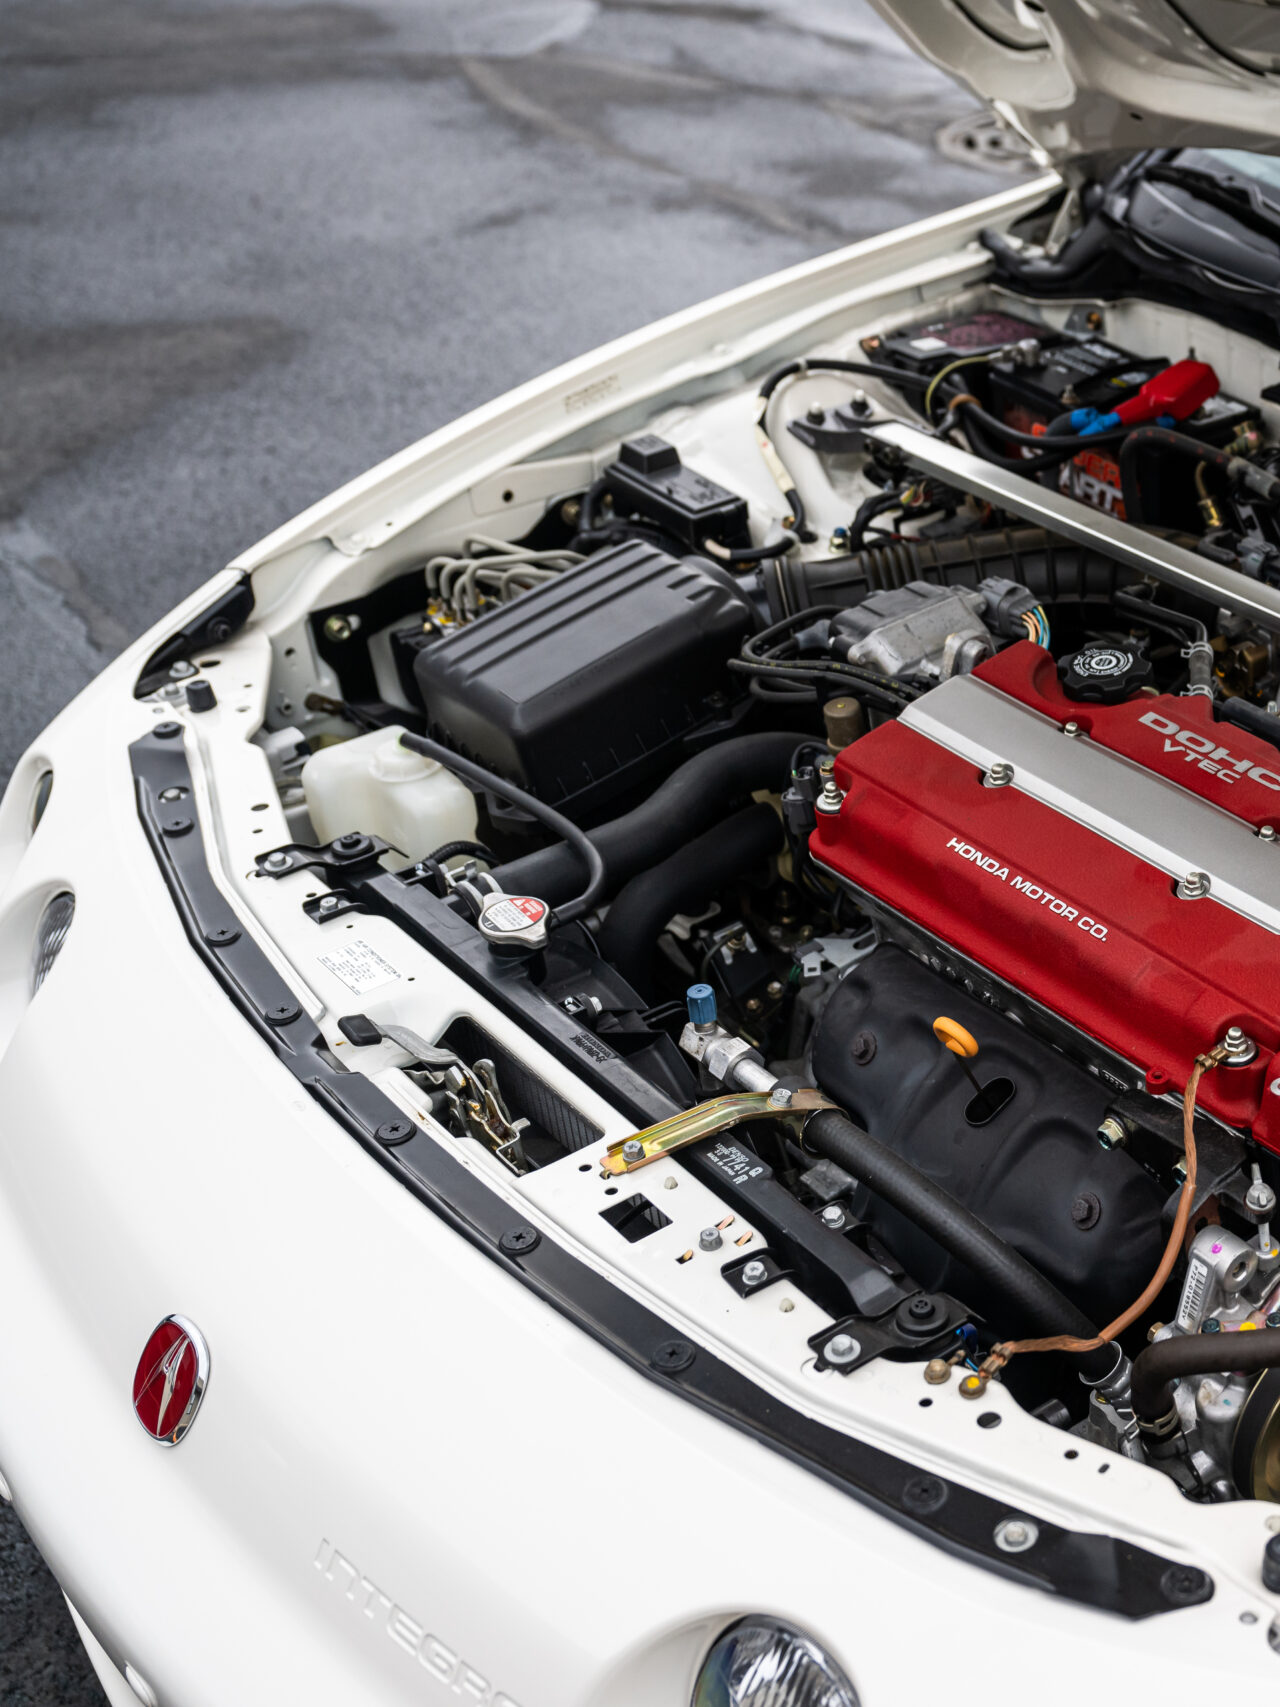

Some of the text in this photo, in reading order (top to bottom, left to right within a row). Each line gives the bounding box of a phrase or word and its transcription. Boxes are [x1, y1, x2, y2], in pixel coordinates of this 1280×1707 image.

[1163, 738, 1242, 785] VTEC
[946, 837, 1109, 942] HONDA MOTOR CO.
[728, 1146, 750, 1162] DENSO
